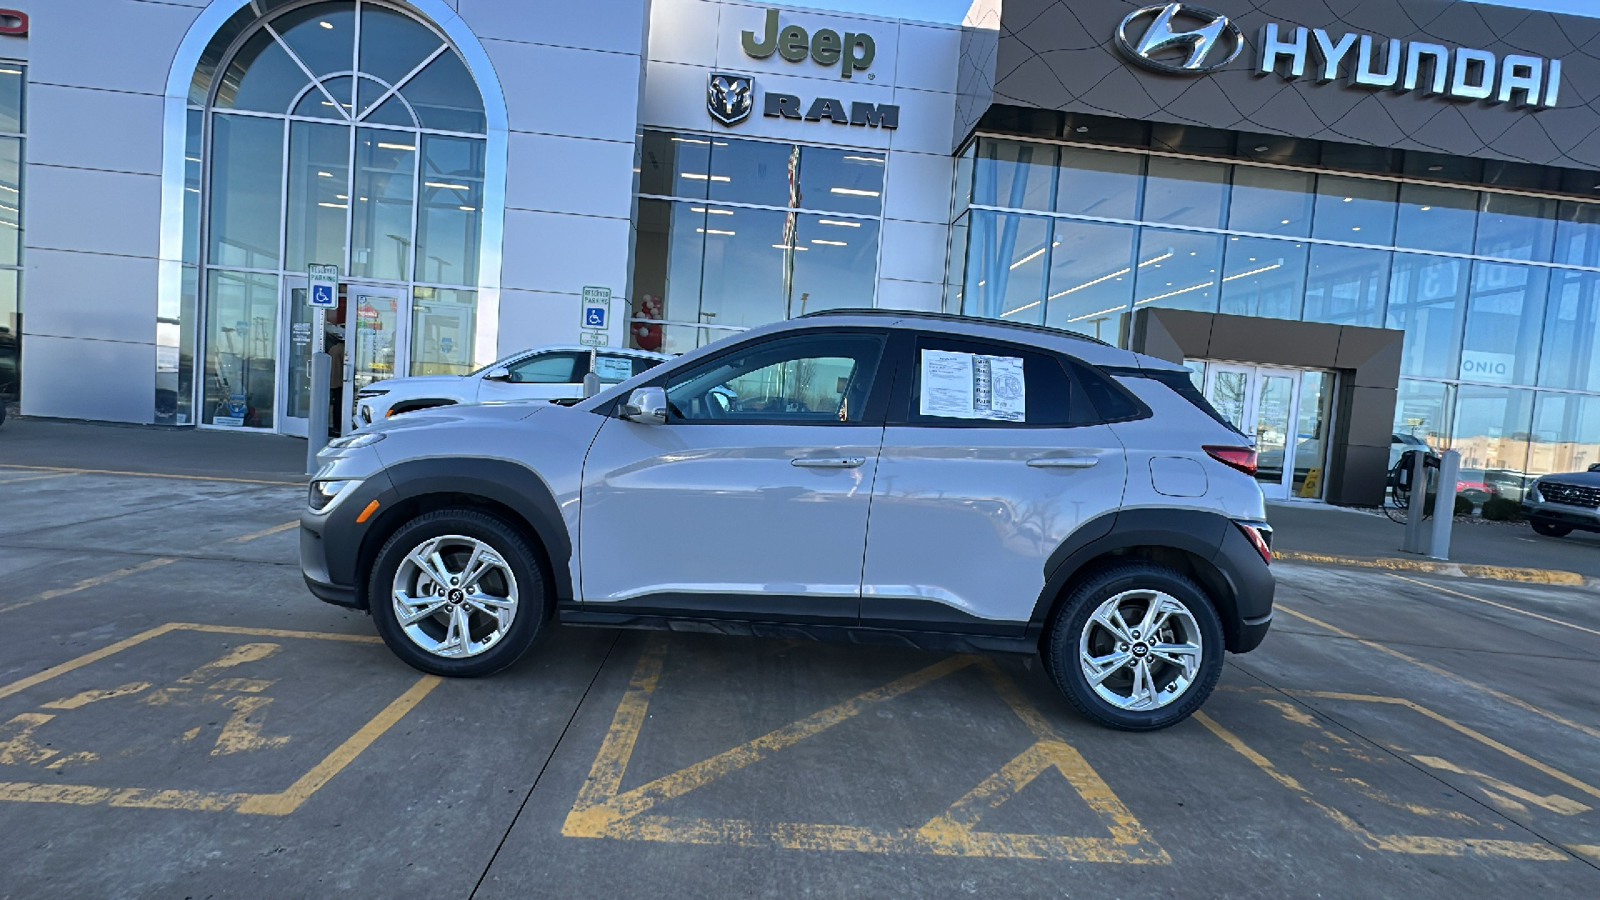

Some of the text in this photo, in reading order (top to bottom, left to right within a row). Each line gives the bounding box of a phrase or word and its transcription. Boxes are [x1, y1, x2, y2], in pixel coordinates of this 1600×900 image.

[741, 9, 876, 78] Jeep
[1258, 22, 1562, 109] HYUNDAI
[763, 92, 900, 130] RAM
[311, 274, 336, 282] PARKING
[585, 297, 609, 305] PARKING
